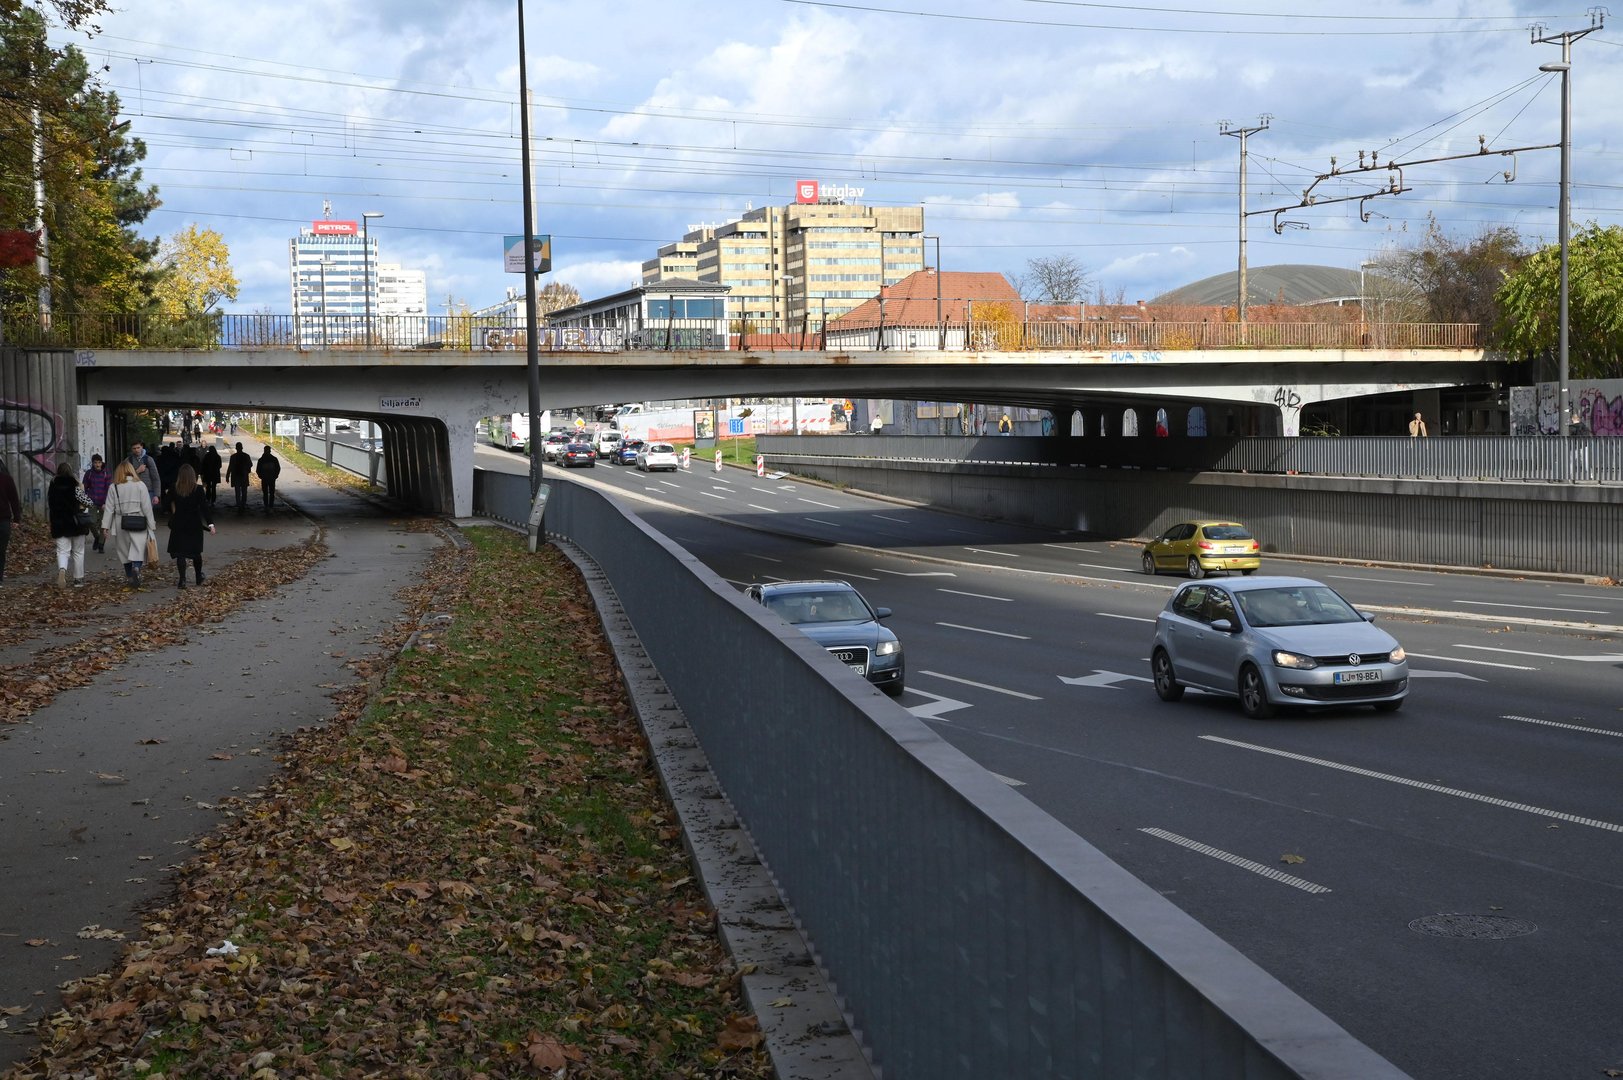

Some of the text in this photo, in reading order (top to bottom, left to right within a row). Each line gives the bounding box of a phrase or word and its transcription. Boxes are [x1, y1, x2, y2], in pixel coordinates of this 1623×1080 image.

[821, 183, 865, 201] triglav
[1341, 672, 1380, 682] LJ 19-BEA
